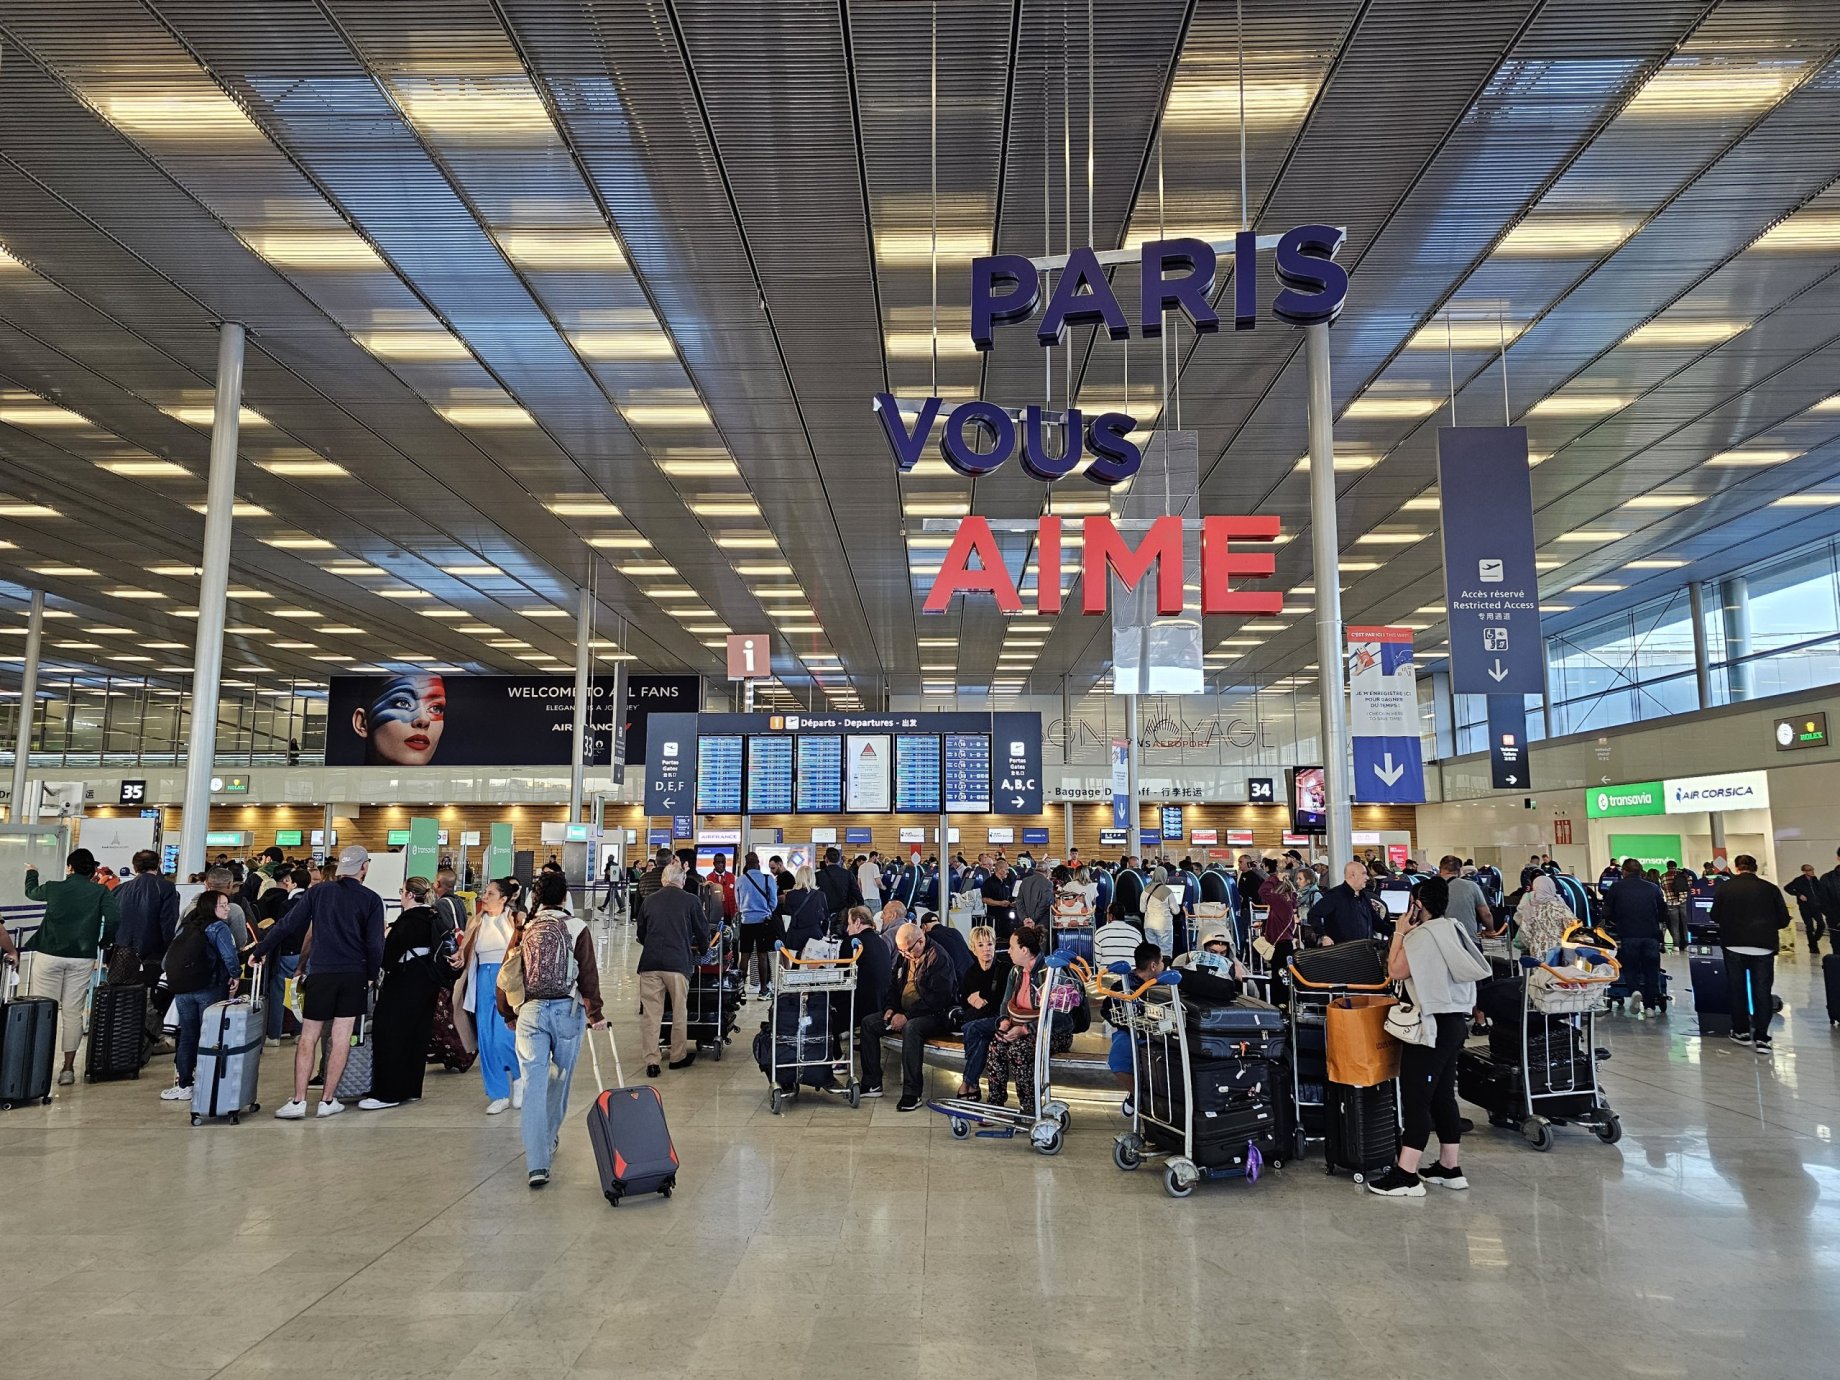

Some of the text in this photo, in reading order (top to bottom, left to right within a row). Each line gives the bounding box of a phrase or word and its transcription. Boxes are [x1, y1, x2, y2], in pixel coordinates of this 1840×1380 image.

[970, 223, 1349, 351] PARIS
[873, 392, 1142, 486] VOUS
[922, 515, 1284, 616] AIME
[1461, 589, 1525, 598] Accès réservé
[1453, 601, 1534, 609] Restricted Access
[609, 687, 635, 697] AL
[641, 686, 679, 697] FANS
[801, 719, 836, 728] Départs
[844, 719, 893, 728] Departures
[1800, 732, 1823, 742] ROLEX
[584, 735, 593, 757] 33
[122, 785, 143, 799] 35
[1055, 787, 1100, 798] Baggage
[1252, 783, 1271, 797] 34
[1609, 786, 1754, 807] transavia AIR CORSICA
